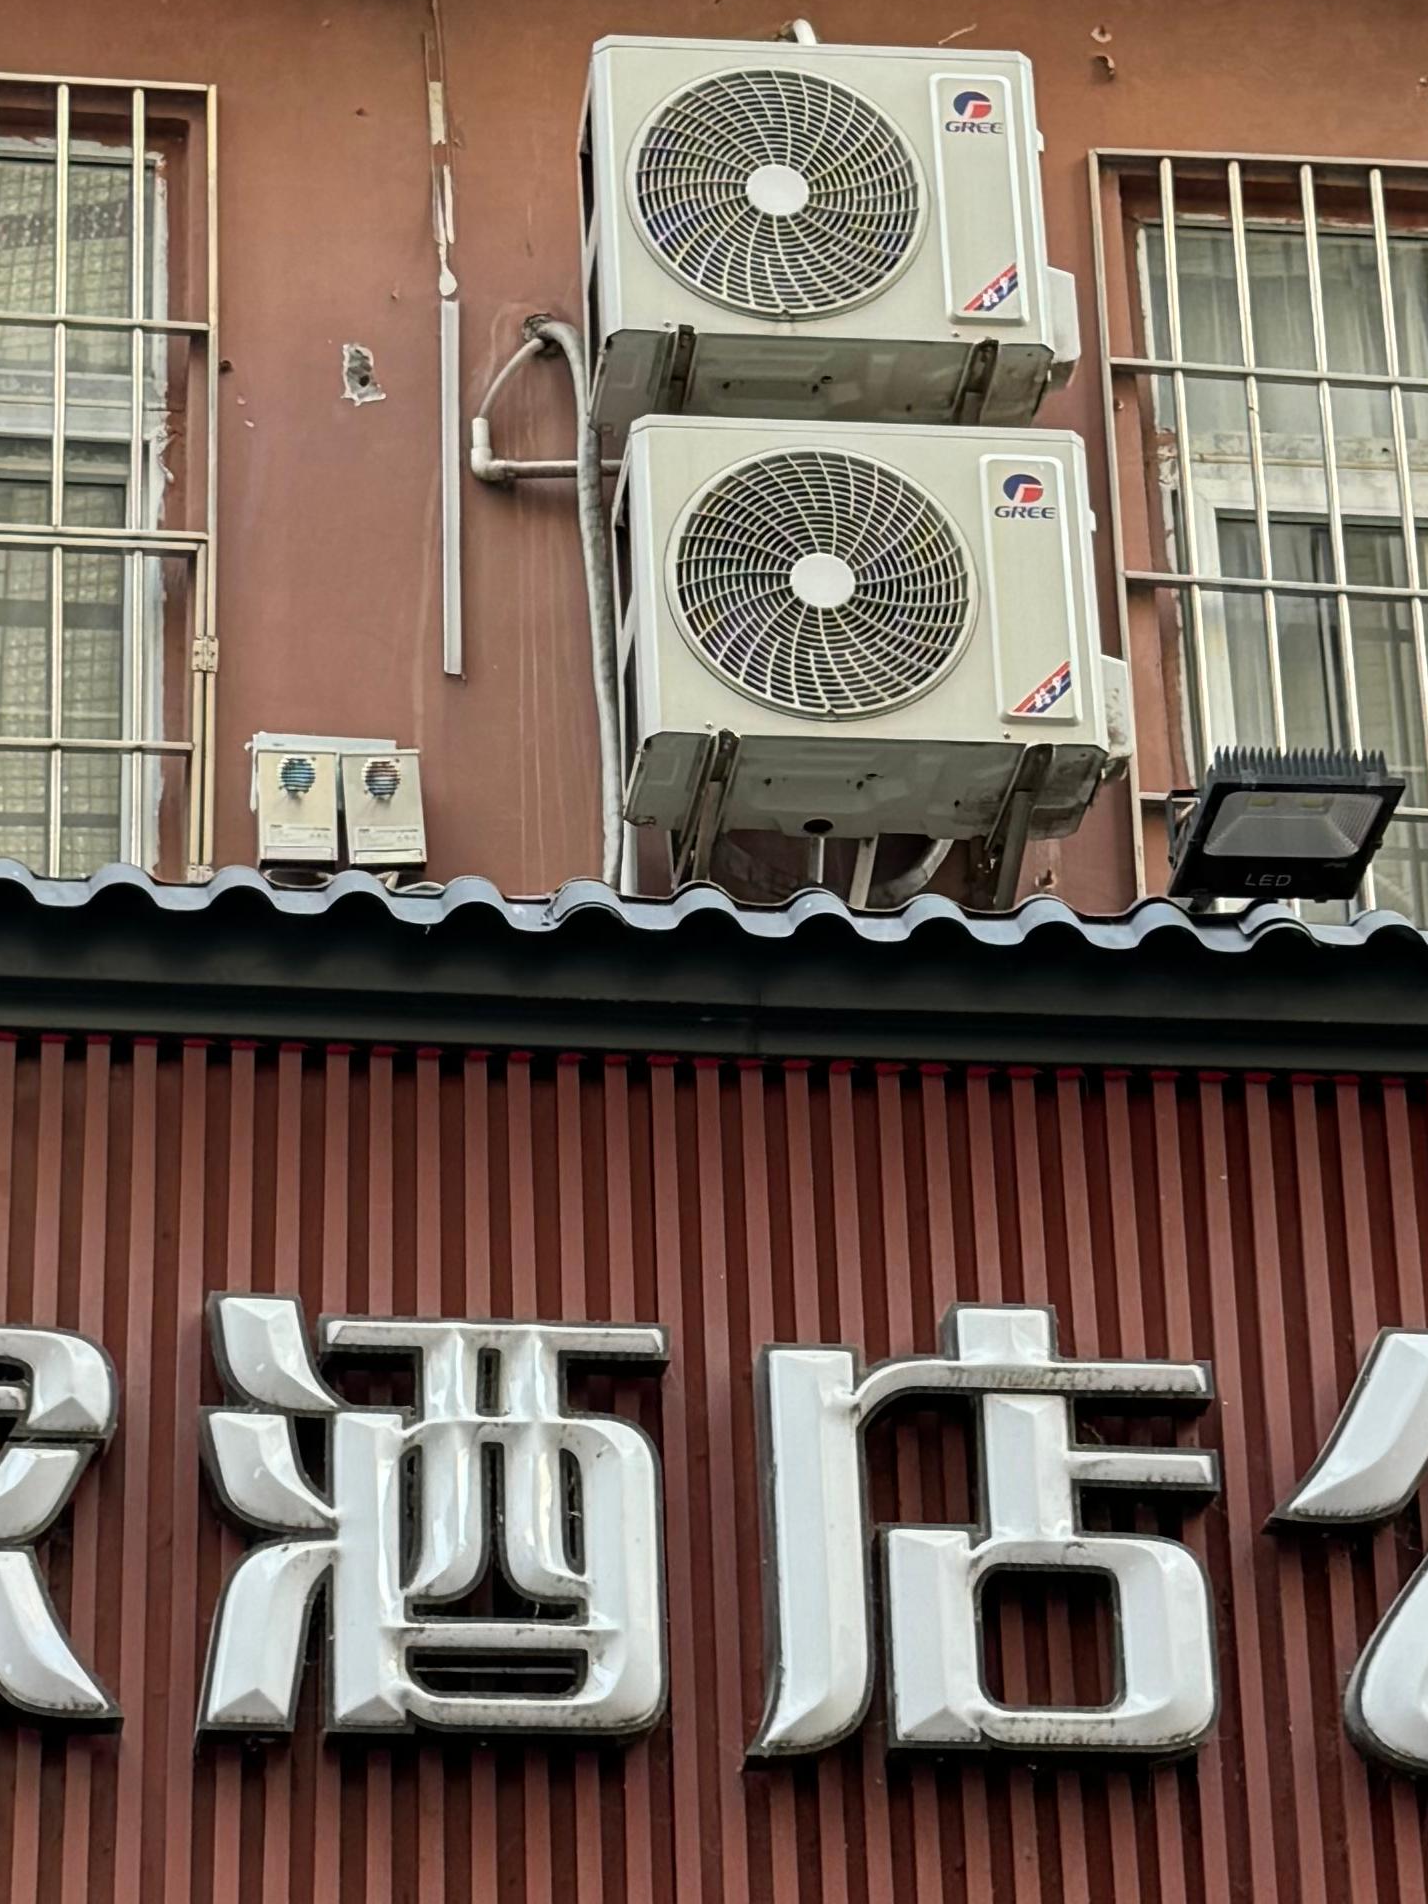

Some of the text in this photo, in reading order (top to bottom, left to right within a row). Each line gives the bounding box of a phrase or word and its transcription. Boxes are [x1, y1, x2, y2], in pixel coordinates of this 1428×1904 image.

[944, 121, 1004, 135] GREE
[994, 505, 1056, 520] GREE
[1244, 872, 1292, 888] LED
